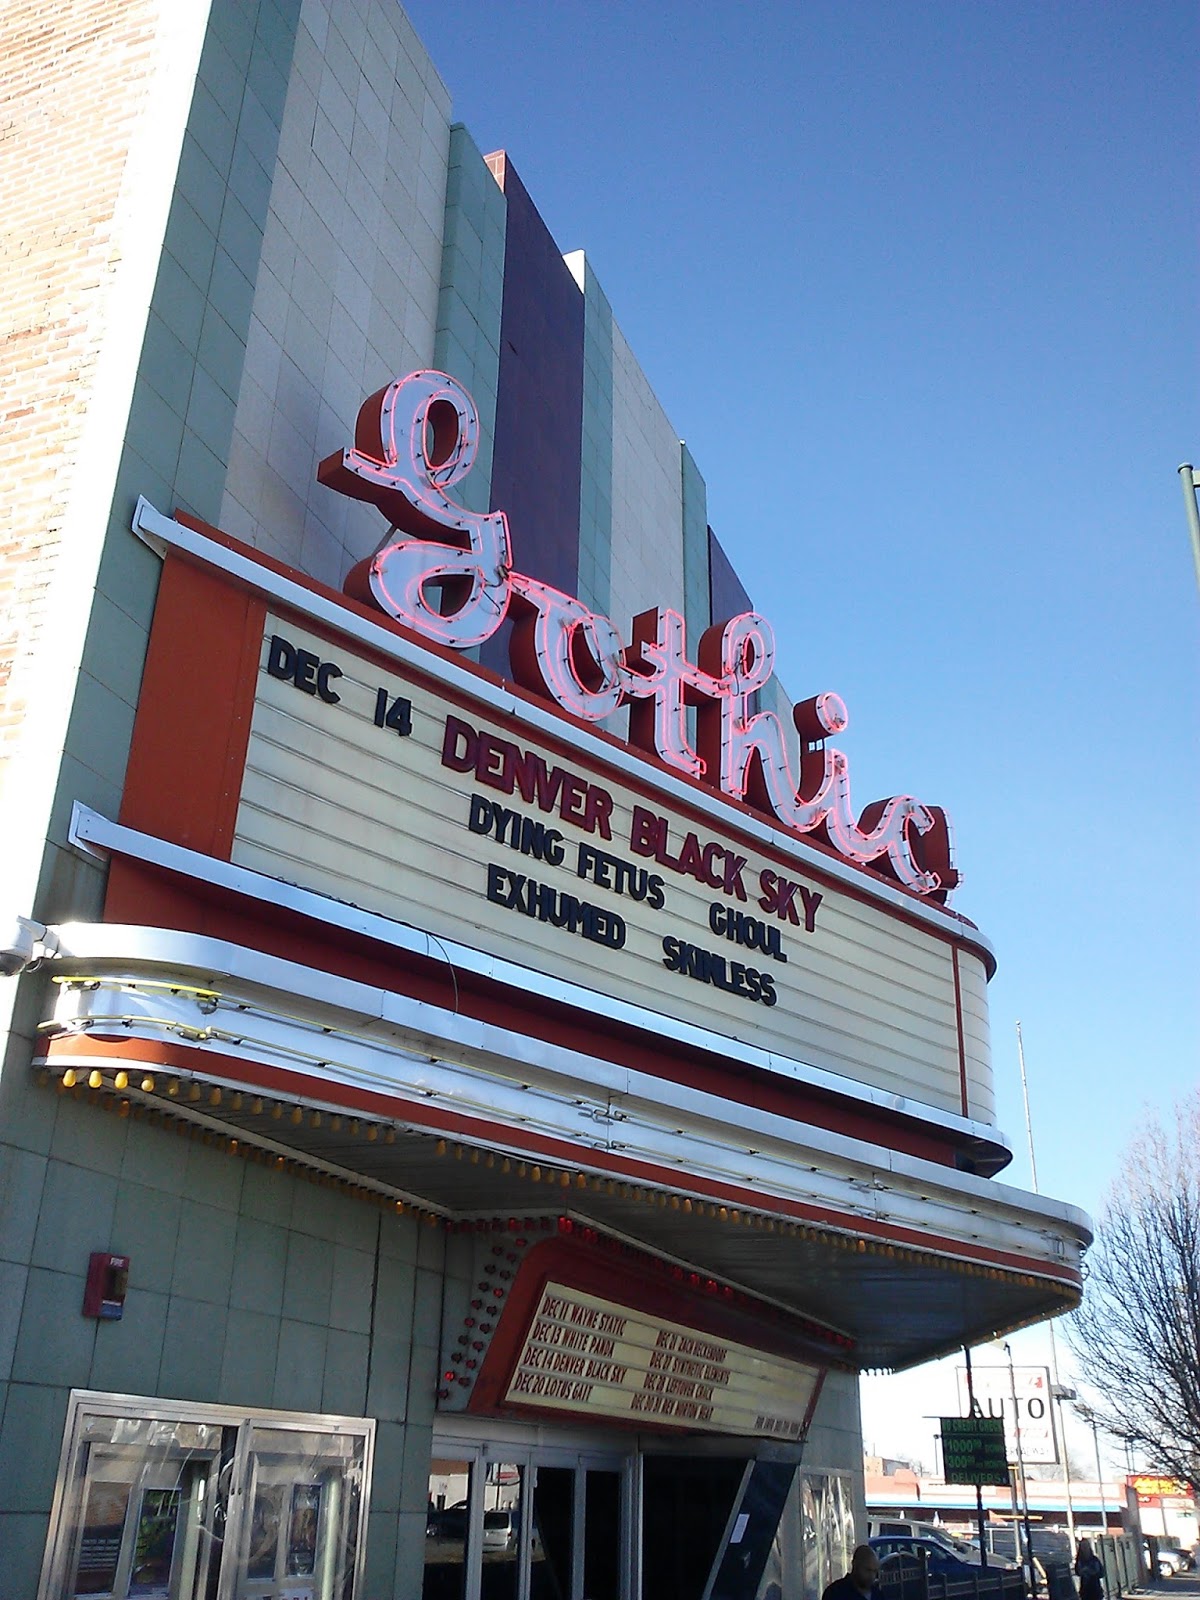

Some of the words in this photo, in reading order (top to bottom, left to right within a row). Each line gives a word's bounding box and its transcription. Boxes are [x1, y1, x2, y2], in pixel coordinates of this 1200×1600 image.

[320, 368, 961, 898] Gothic
[267, 634, 343, 703] DEC
[374, 687, 413, 736] 14
[441, 715, 614, 841] DENVER
[630, 805, 748, 902] BLACK
[757, 869, 823, 932] SKY
[468, 793, 564, 866] DYING
[577, 842, 666, 909] FETUS
[709, 903, 788, 963] GHOUL
[487, 863, 627, 950] EXHUMED
[662, 936, 778, 1006] SKINLESS
[542, 1296, 560, 1318] DEC
[558, 1301, 569, 1320] 11
[571, 1304, 599, 1329] WAYNE
[599, 1314, 627, 1336] STATIC
[533, 1320, 551, 1341] DEC
[550, 1326, 562, 1344] 13
[562, 1329, 589, 1351] WHITE
[589, 1336, 615, 1358] PANDA
[523, 1346, 543, 1367] DEC
[541, 1350, 555, 1369] 14
[553, 1353, 585, 1376] DENVER
[586, 1360, 611, 1381] BLACK
[610, 1365, 628, 1384] SKY
[514, 1372, 534, 1393] DEC
[532, 1376, 545, 1394] 20
[544, 1378, 573, 1400] LOTUS
[572, 1383, 594, 1402] GAIT
[969, 1397, 1045, 1419] AUTO
